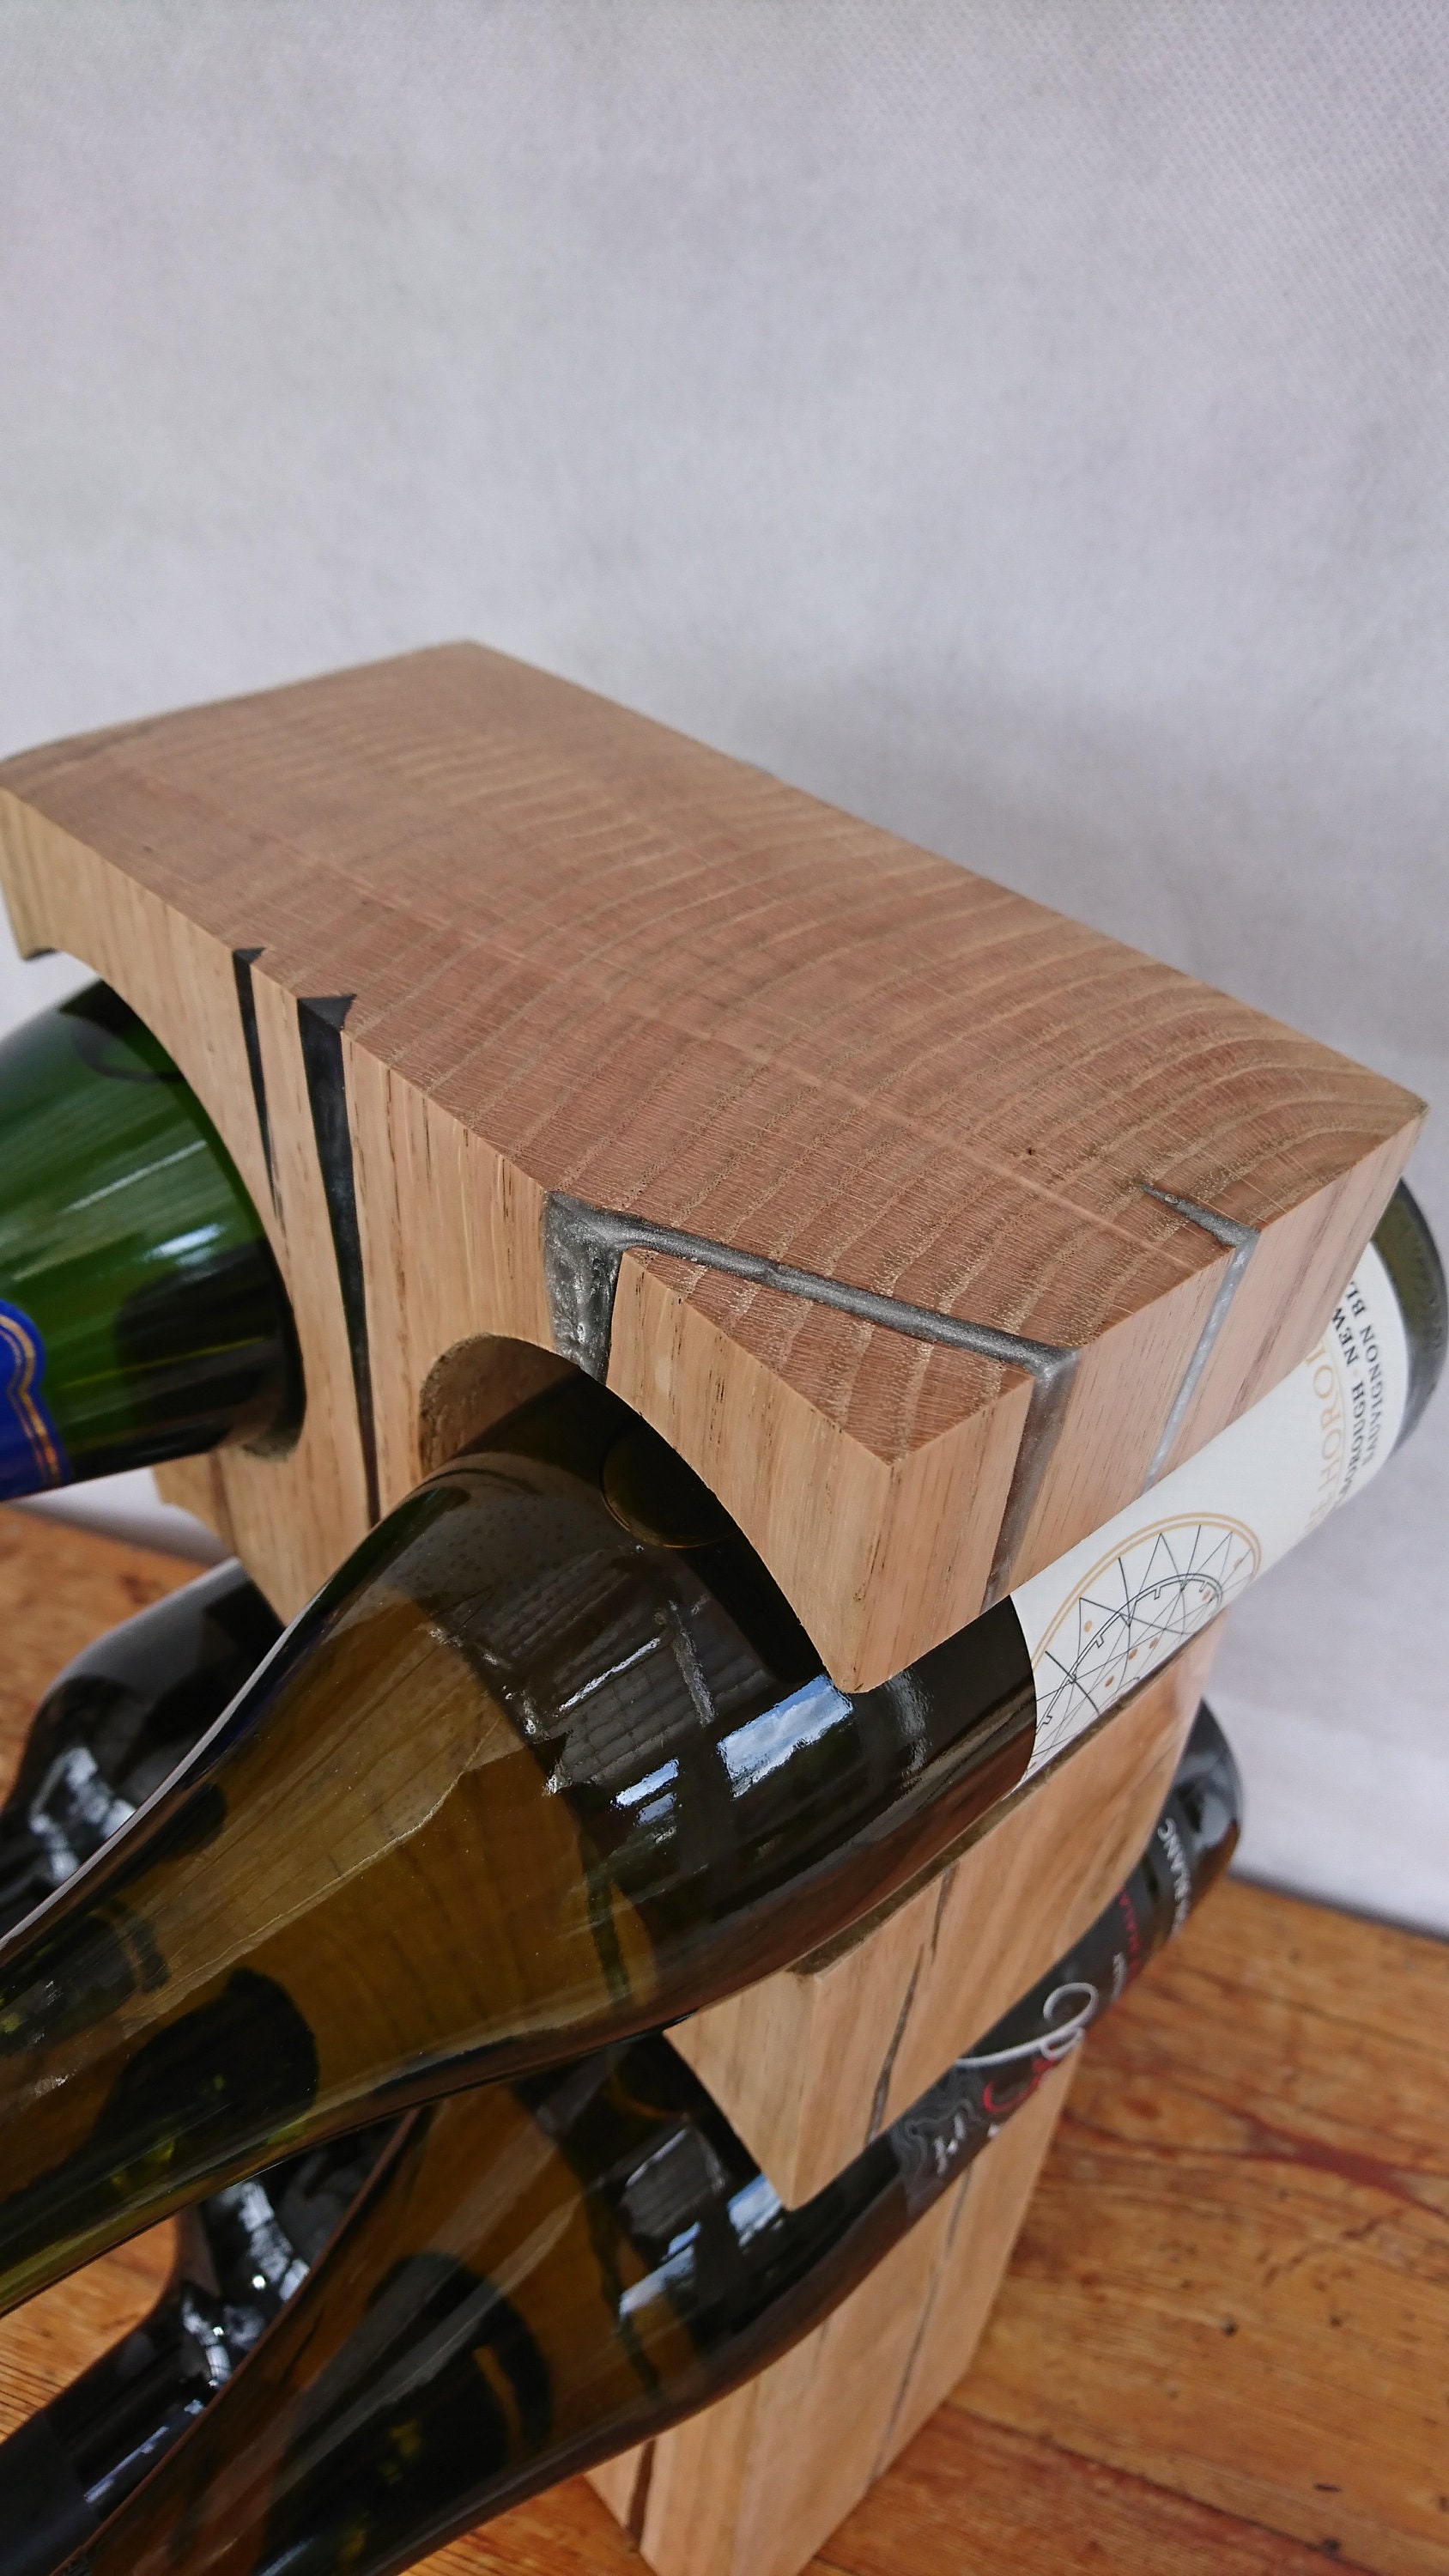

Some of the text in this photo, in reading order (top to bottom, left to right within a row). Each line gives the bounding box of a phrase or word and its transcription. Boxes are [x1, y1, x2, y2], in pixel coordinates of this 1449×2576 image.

[1306, 1344, 1342, 1492] HOROL
[1331, 1308, 1367, 1510] BOROUGH NEW
[1347, 1280, 1384, 1466] SAUVIGNON BL
